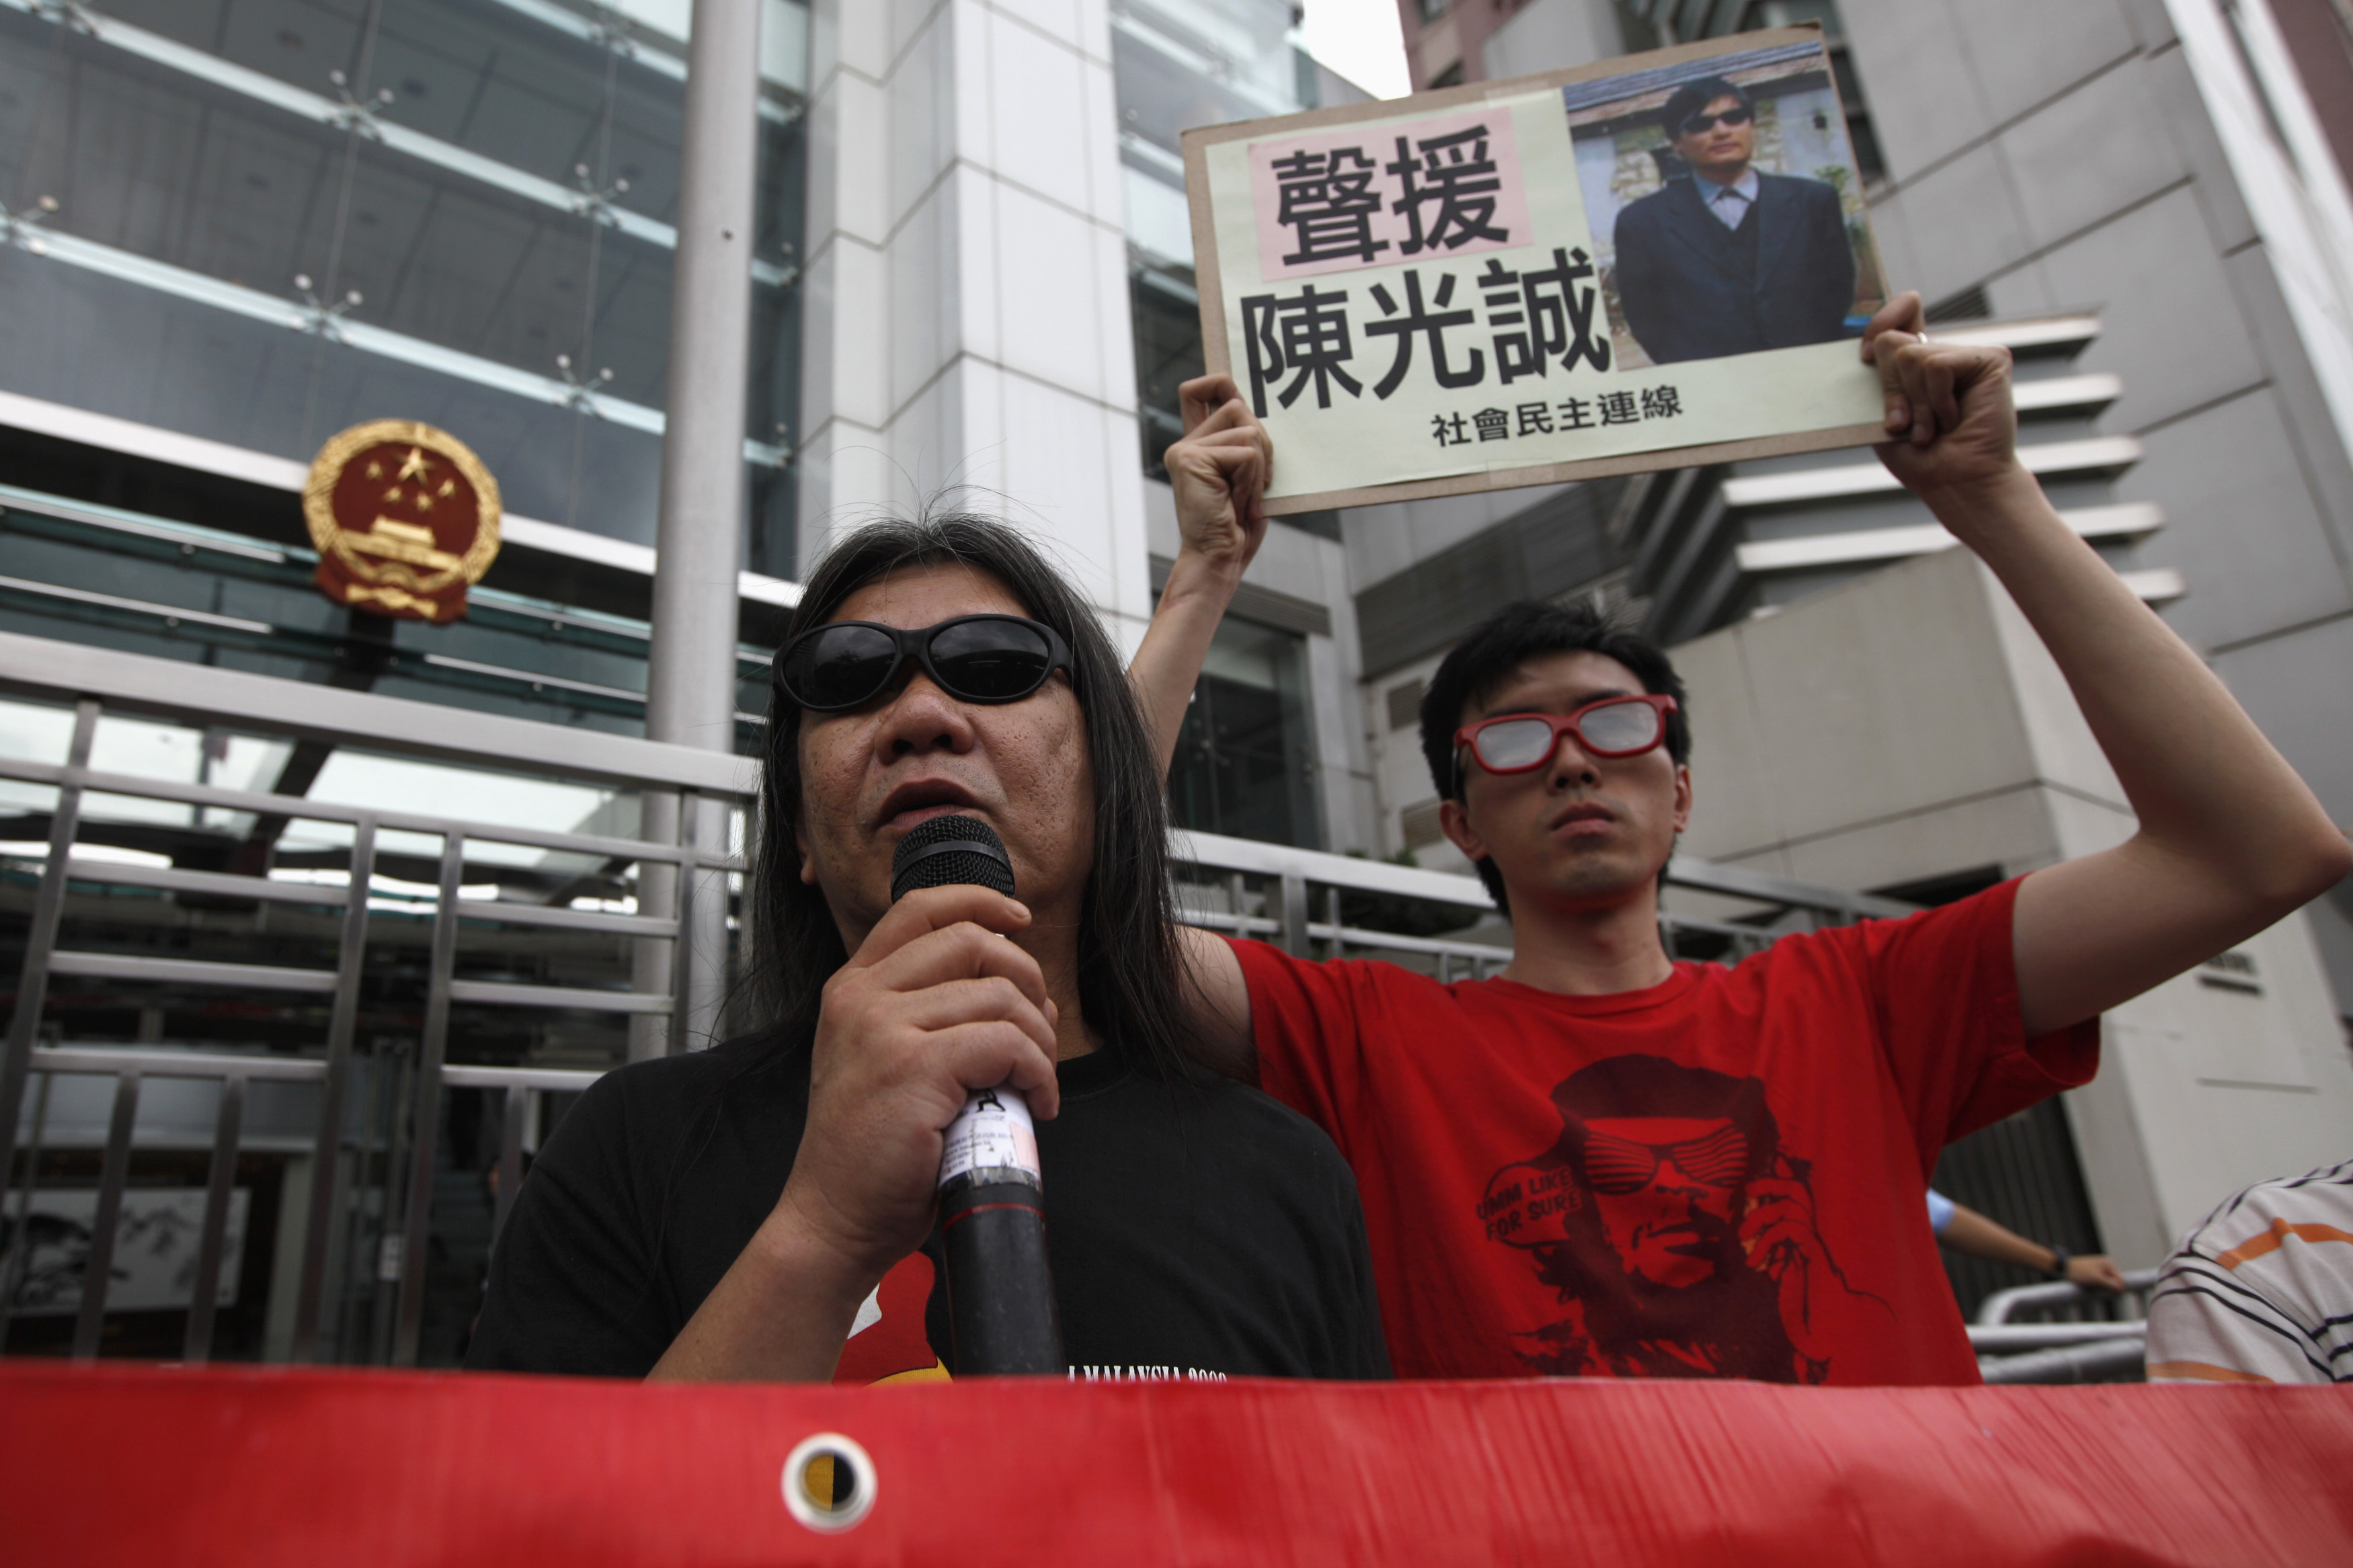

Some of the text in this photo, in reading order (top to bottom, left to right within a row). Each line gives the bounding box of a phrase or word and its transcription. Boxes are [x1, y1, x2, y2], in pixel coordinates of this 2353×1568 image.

[1271, 124, 1511, 266] 聲援
[1240, 246, 1611, 418] 陳光誠
[1430, 384, 1684, 448] 社會民主連線
[1476, 1167, 1570, 1220] UMM LIKE
[1486, 1189, 1581, 1241] FOR SURE
